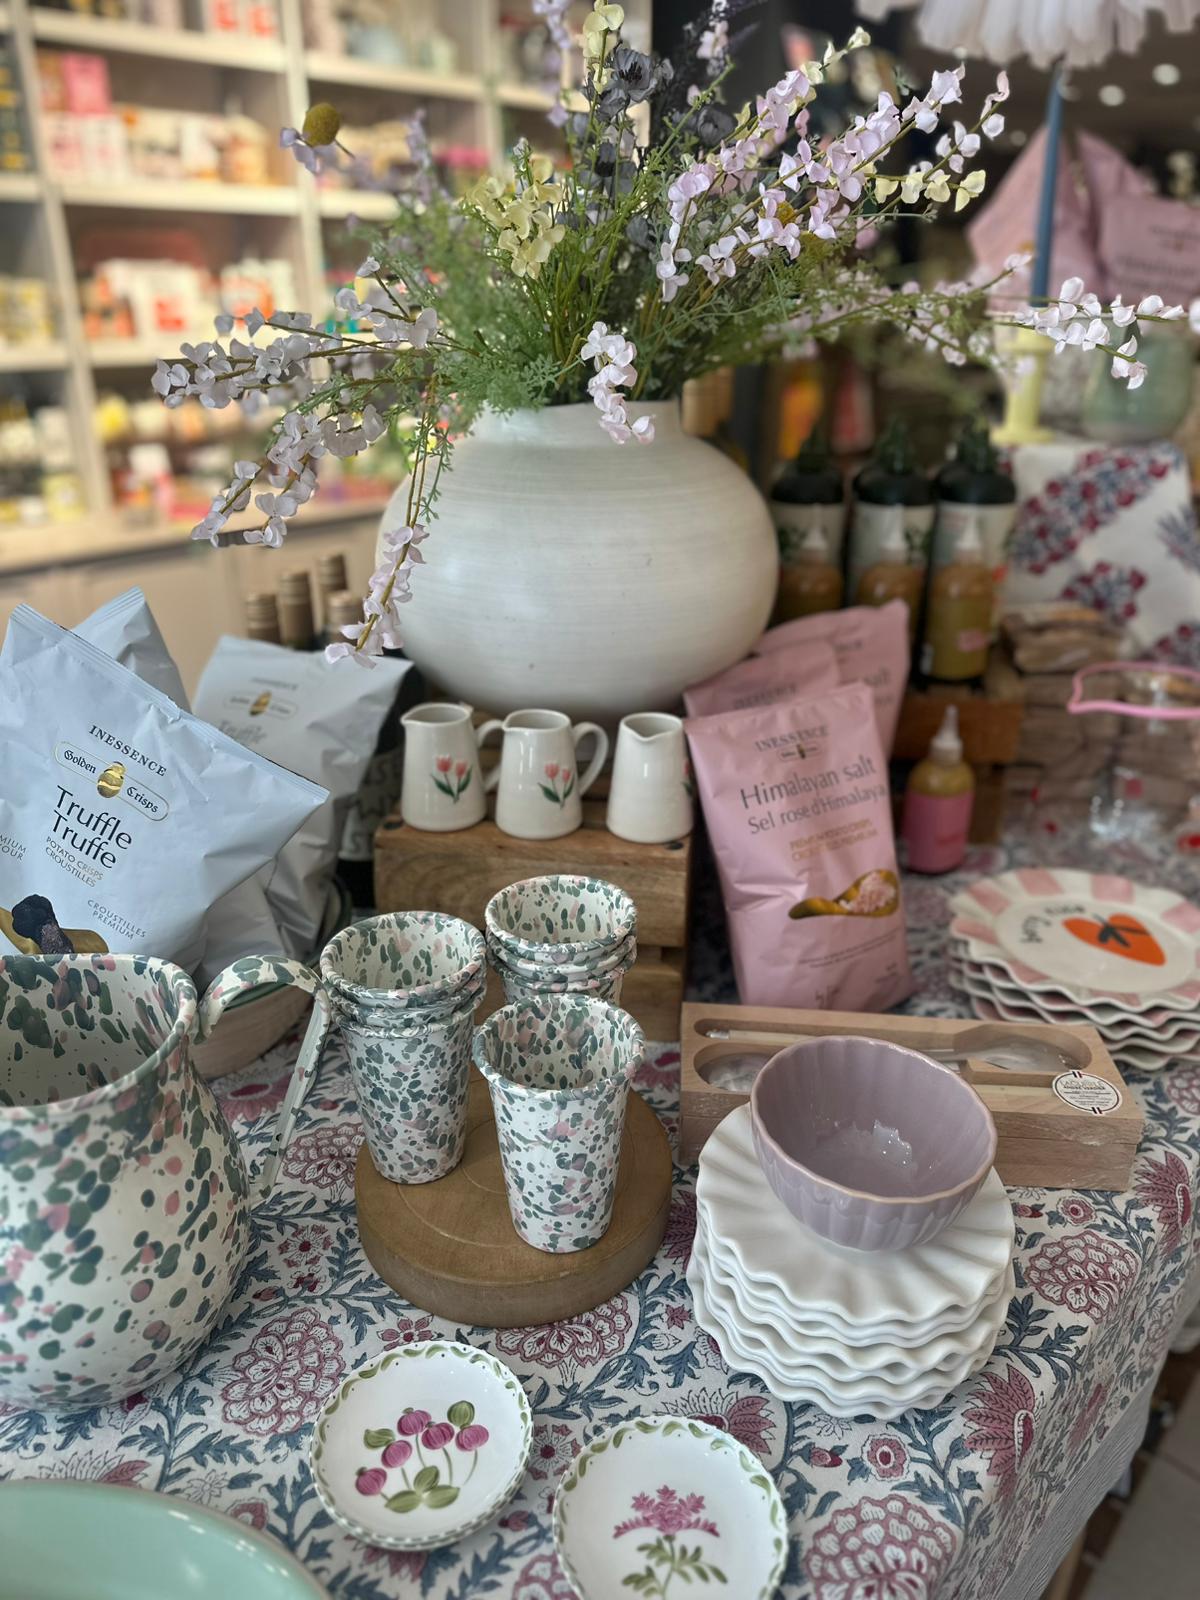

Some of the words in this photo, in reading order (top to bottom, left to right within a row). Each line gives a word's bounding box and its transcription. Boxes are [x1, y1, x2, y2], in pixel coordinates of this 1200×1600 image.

[88, 725, 167, 777] INESSENCE
[63, 749, 97, 774] Golden
[126, 786, 159, 813] Crisps
[740, 771, 840, 810] Himalayan
[843, 754, 876, 779] salt
[52, 809, 117, 869] Truffe
[55, 785, 133, 850] Truffle
[748, 811, 776, 835] Sel
[780, 804, 809, 826] rose
[0, 843, 23, 861] OUR
[45, 846, 96, 888] CROUSTILLES
[46, 836, 76, 863] POTATO
[76, 860, 103, 881] CRISPS
[87, 900, 147, 938] CROUSTILLES
[92, 911, 135, 940] PREMIUM
